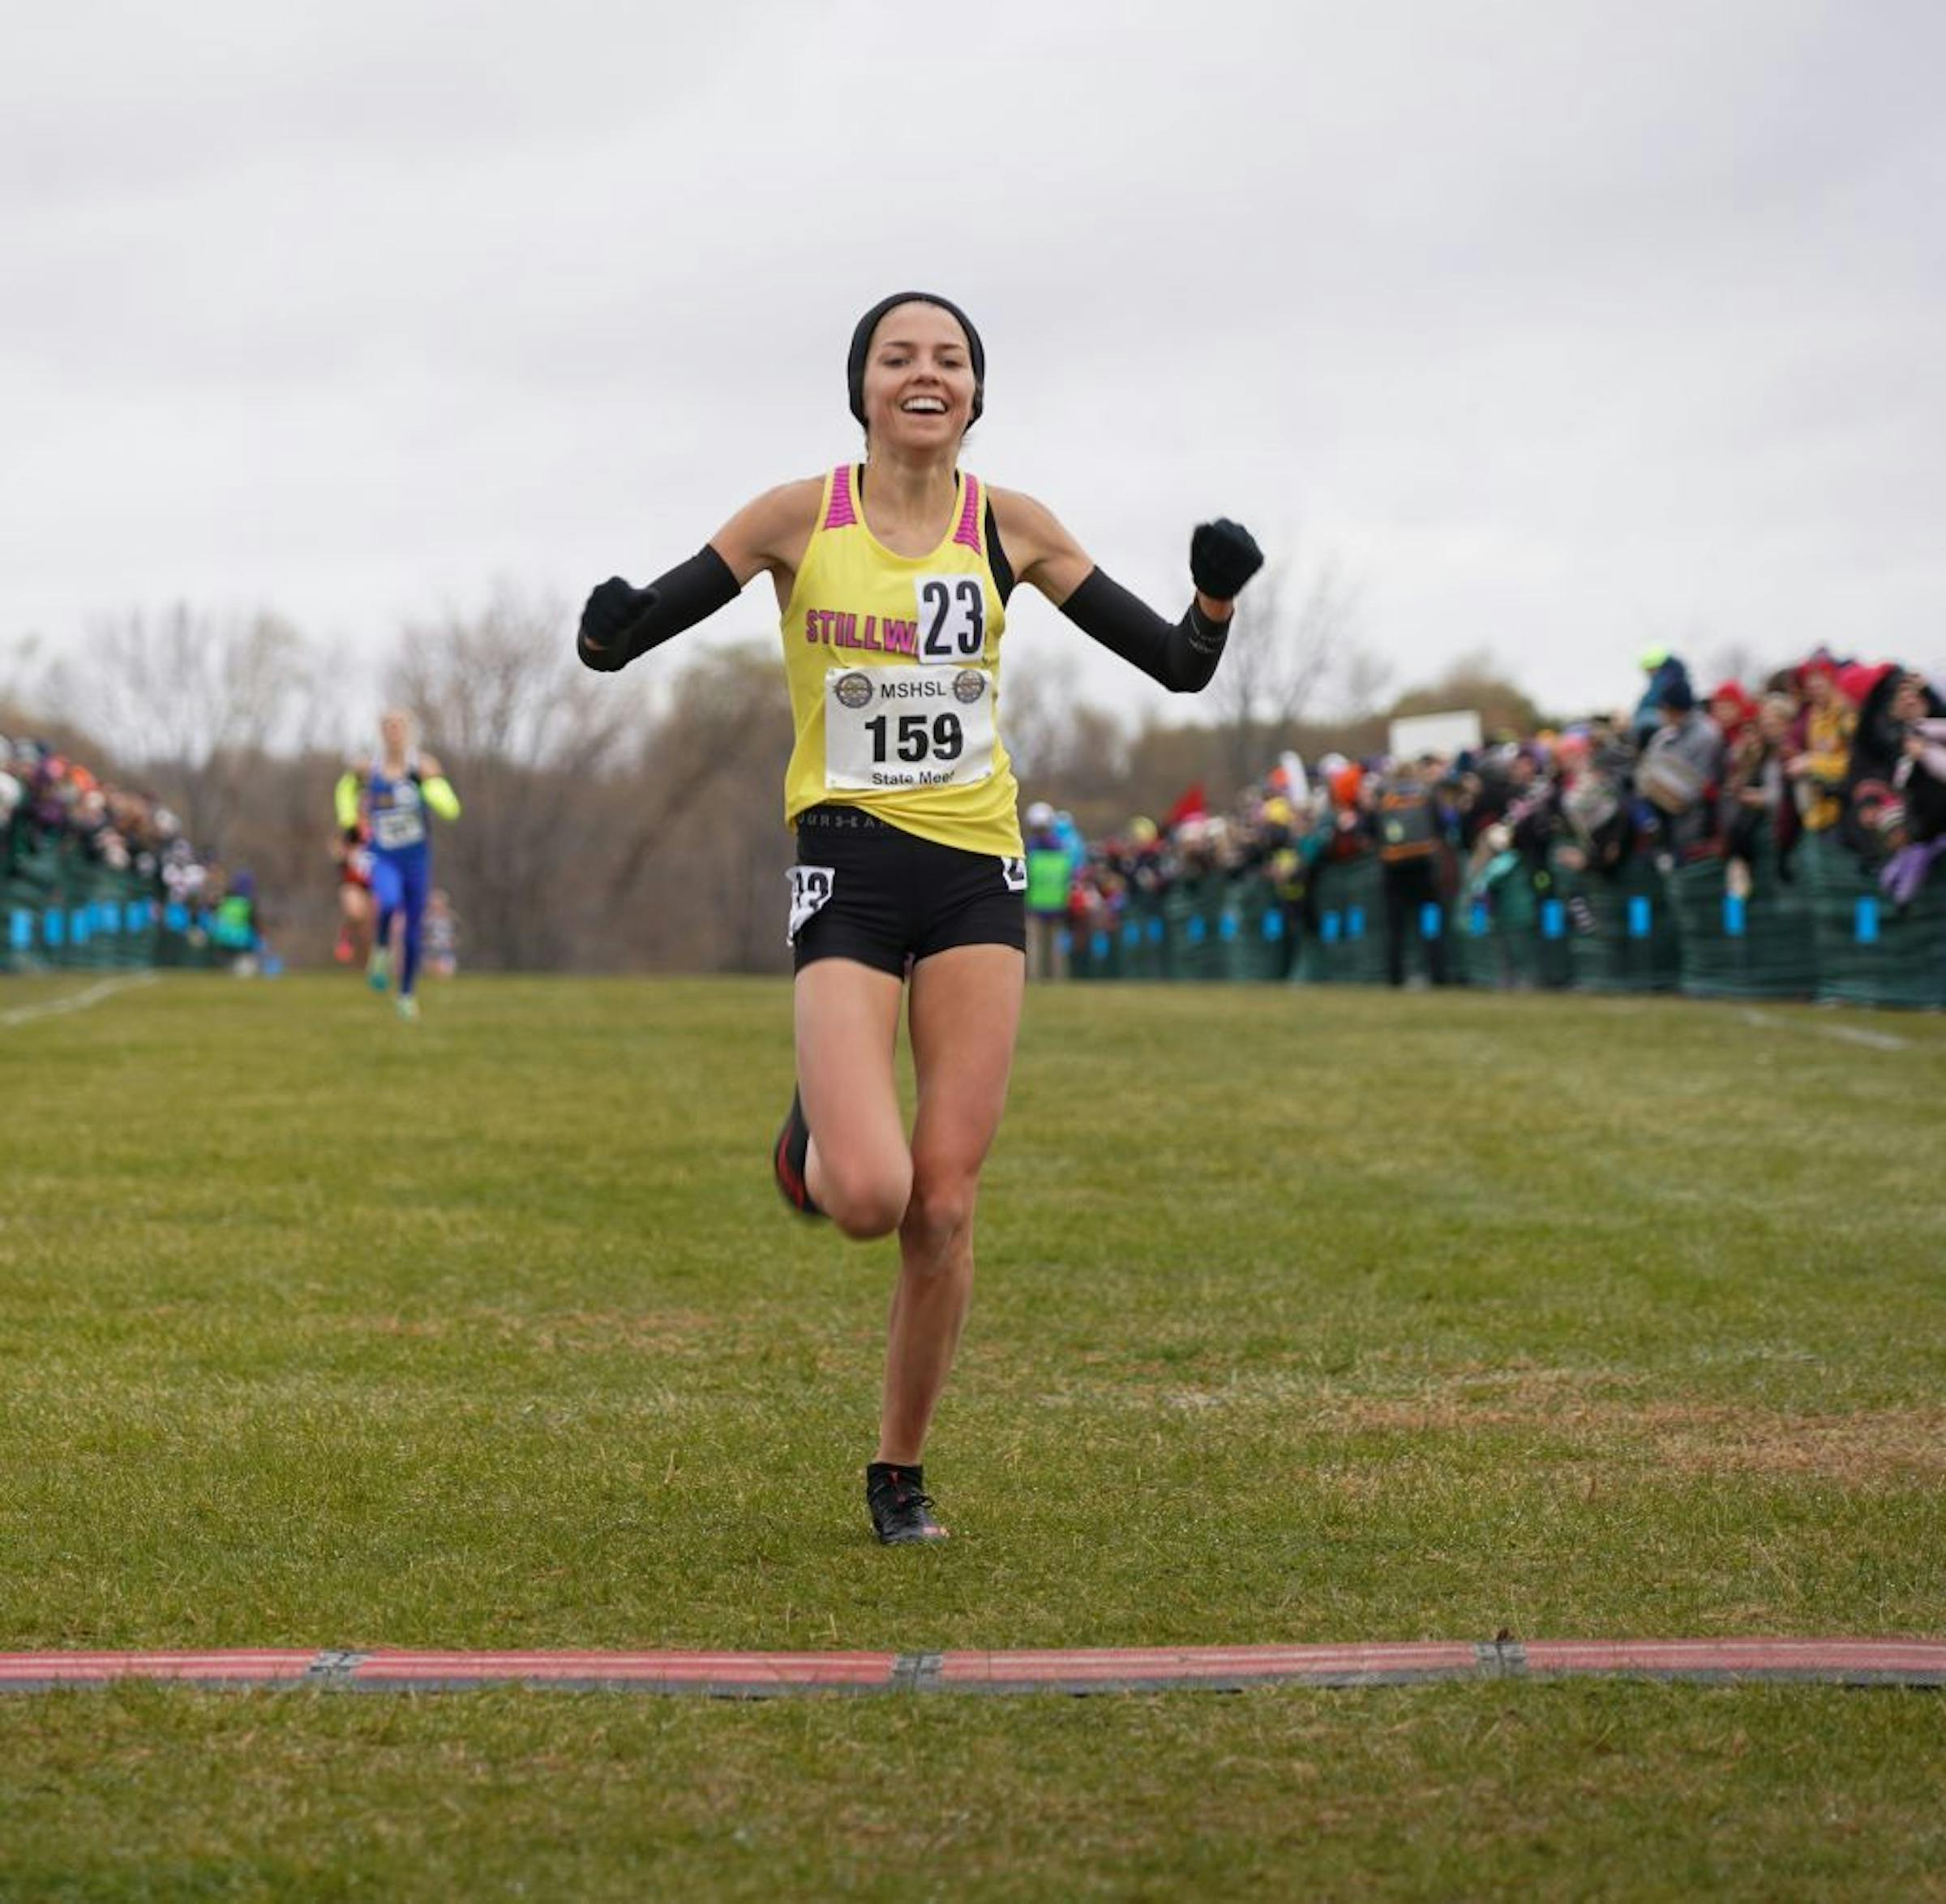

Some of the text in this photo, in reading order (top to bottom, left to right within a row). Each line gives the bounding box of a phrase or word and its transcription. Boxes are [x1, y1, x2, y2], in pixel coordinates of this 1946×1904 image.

[805, 610, 919, 658] STILLW
[923, 581, 983, 655] 23
[881, 682, 946, 698] MSHSL
[865, 713, 963, 762] 159
[872, 773, 914, 785] State
